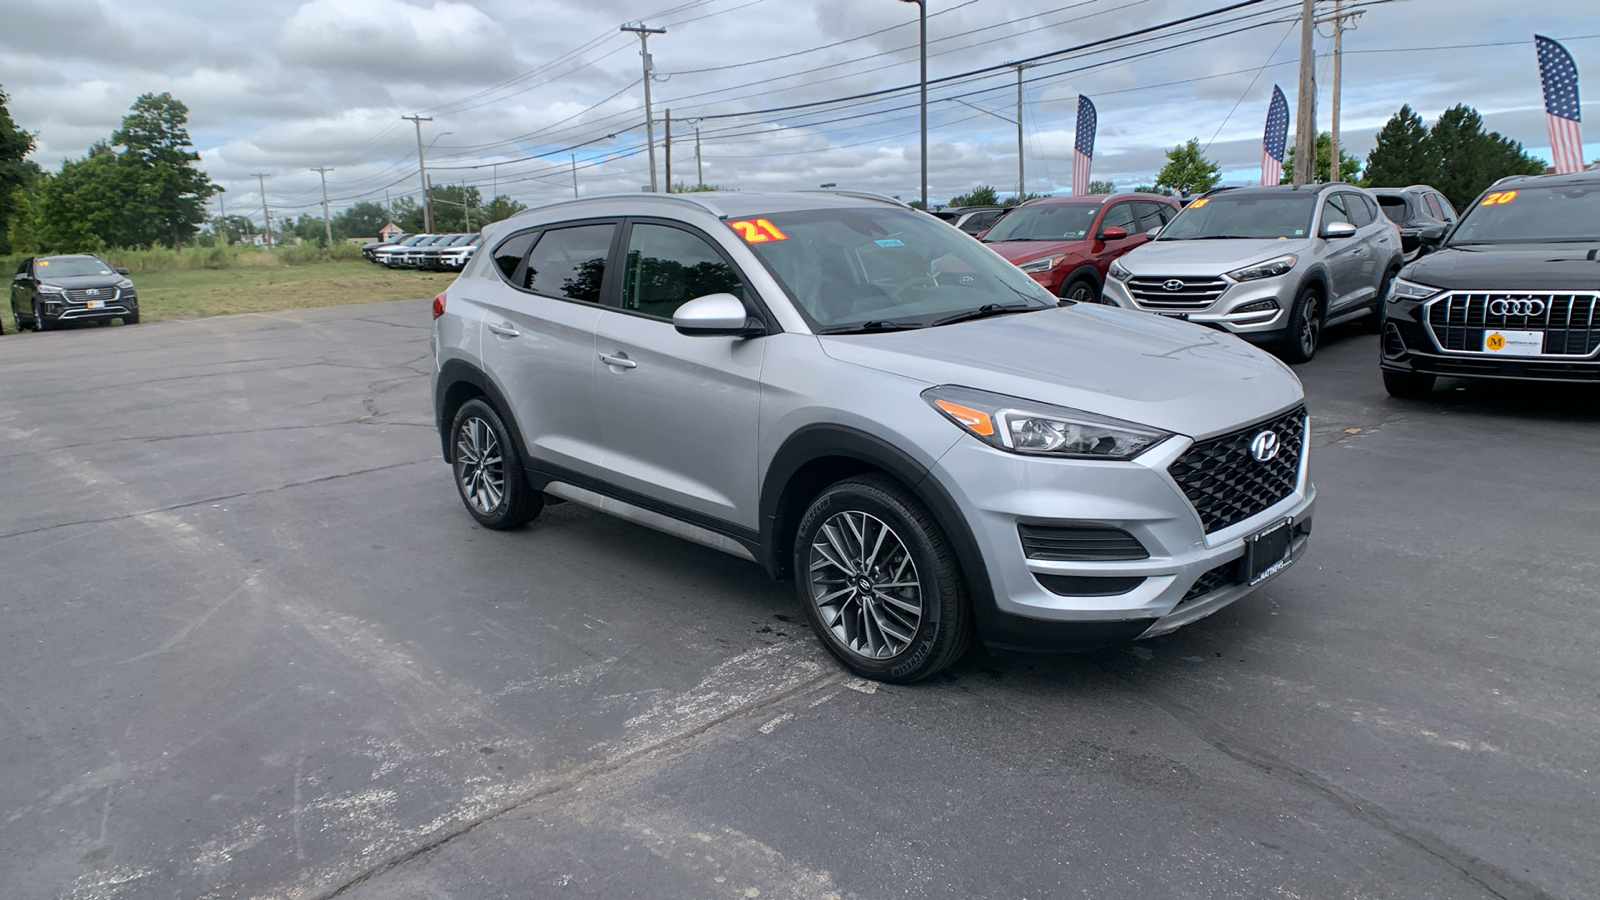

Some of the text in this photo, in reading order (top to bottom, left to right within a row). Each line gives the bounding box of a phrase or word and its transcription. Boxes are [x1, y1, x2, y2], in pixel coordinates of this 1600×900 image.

[1481, 191, 1517, 205] 20
[732, 219, 786, 241] 21
[1490, 338, 1502, 347] M
